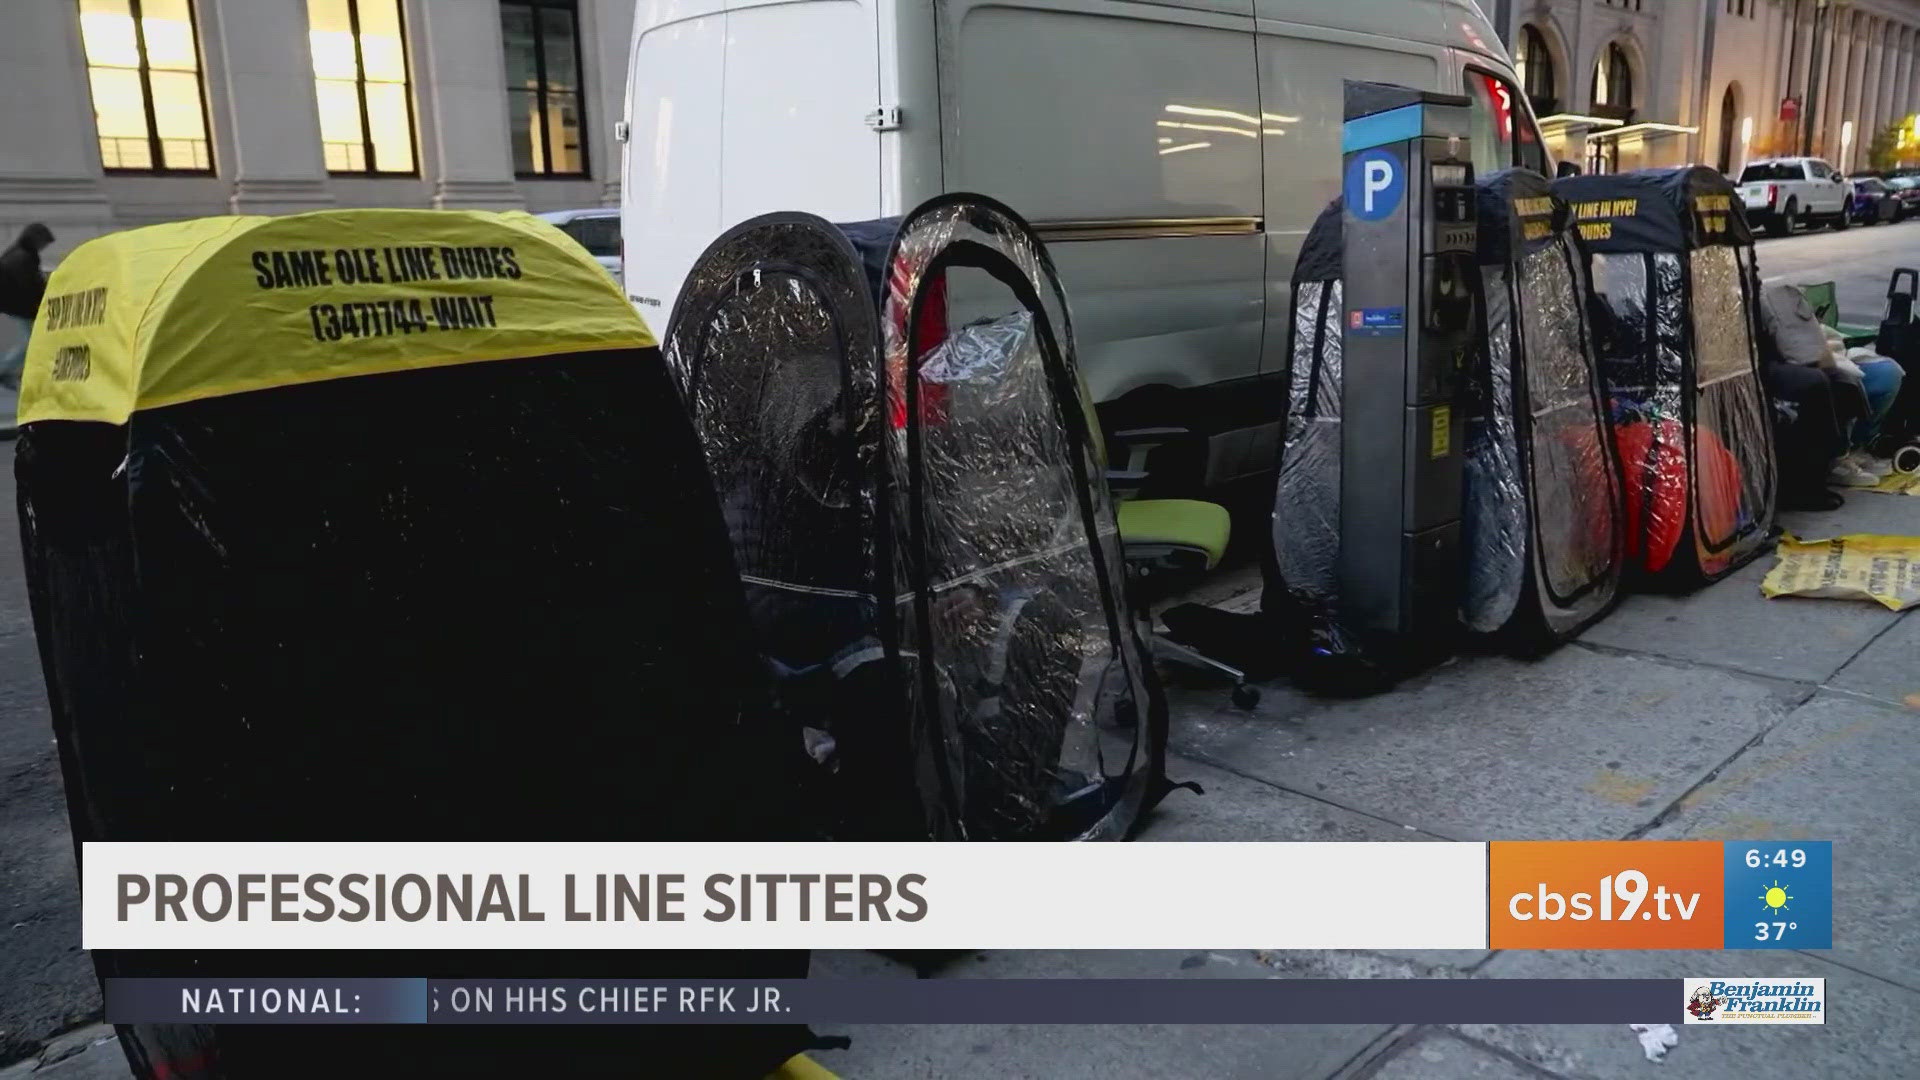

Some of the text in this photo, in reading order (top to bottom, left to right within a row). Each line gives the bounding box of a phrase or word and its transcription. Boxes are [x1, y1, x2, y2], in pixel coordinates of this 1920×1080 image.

[1364, 160, 1393, 211] P
[1578, 202, 1601, 219] LINE
[1600, 201, 1612, 217] IN
[251, 246, 522, 288] SAME OLE LINE DUDES
